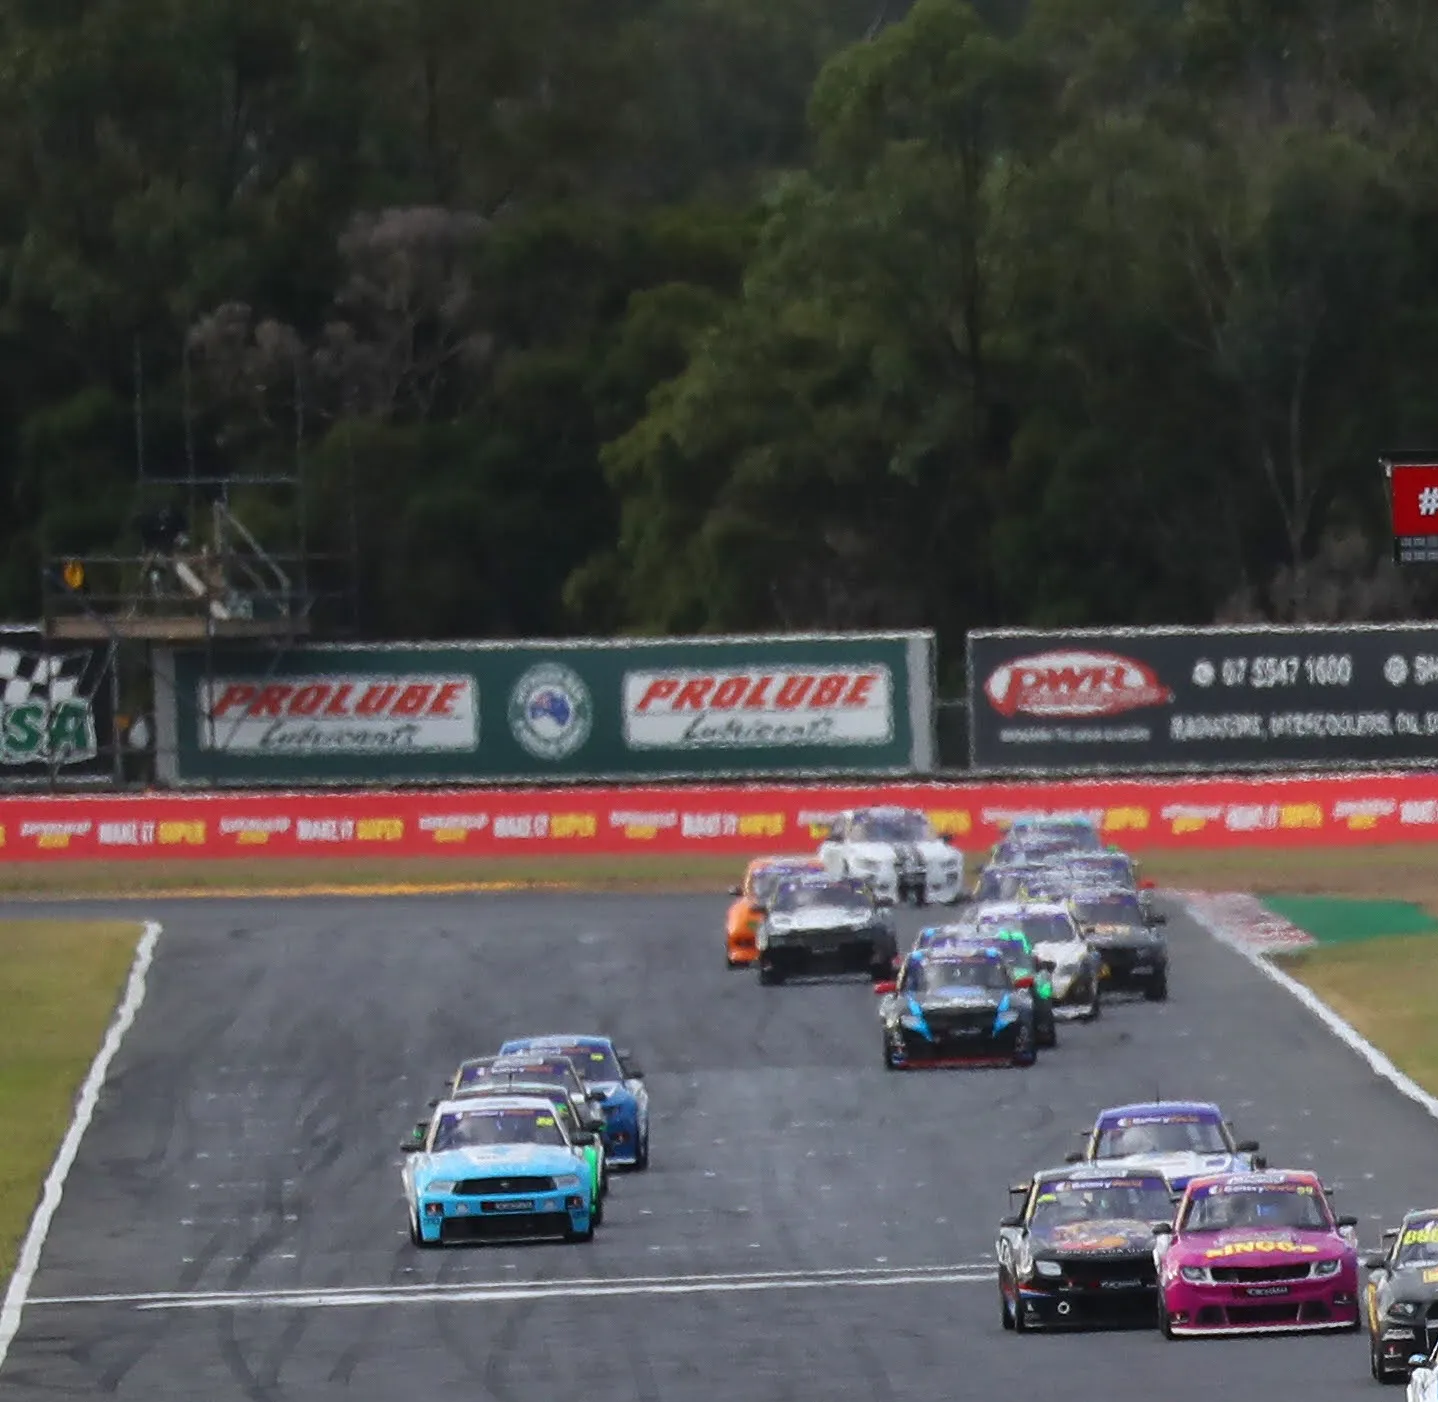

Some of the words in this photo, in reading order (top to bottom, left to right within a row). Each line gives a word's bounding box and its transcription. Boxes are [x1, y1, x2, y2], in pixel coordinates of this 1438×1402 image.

[213, 682, 468, 717] PROLUBE
[635, 673, 880, 713] PROLUBE
[1003, 665, 1127, 715] PWR
